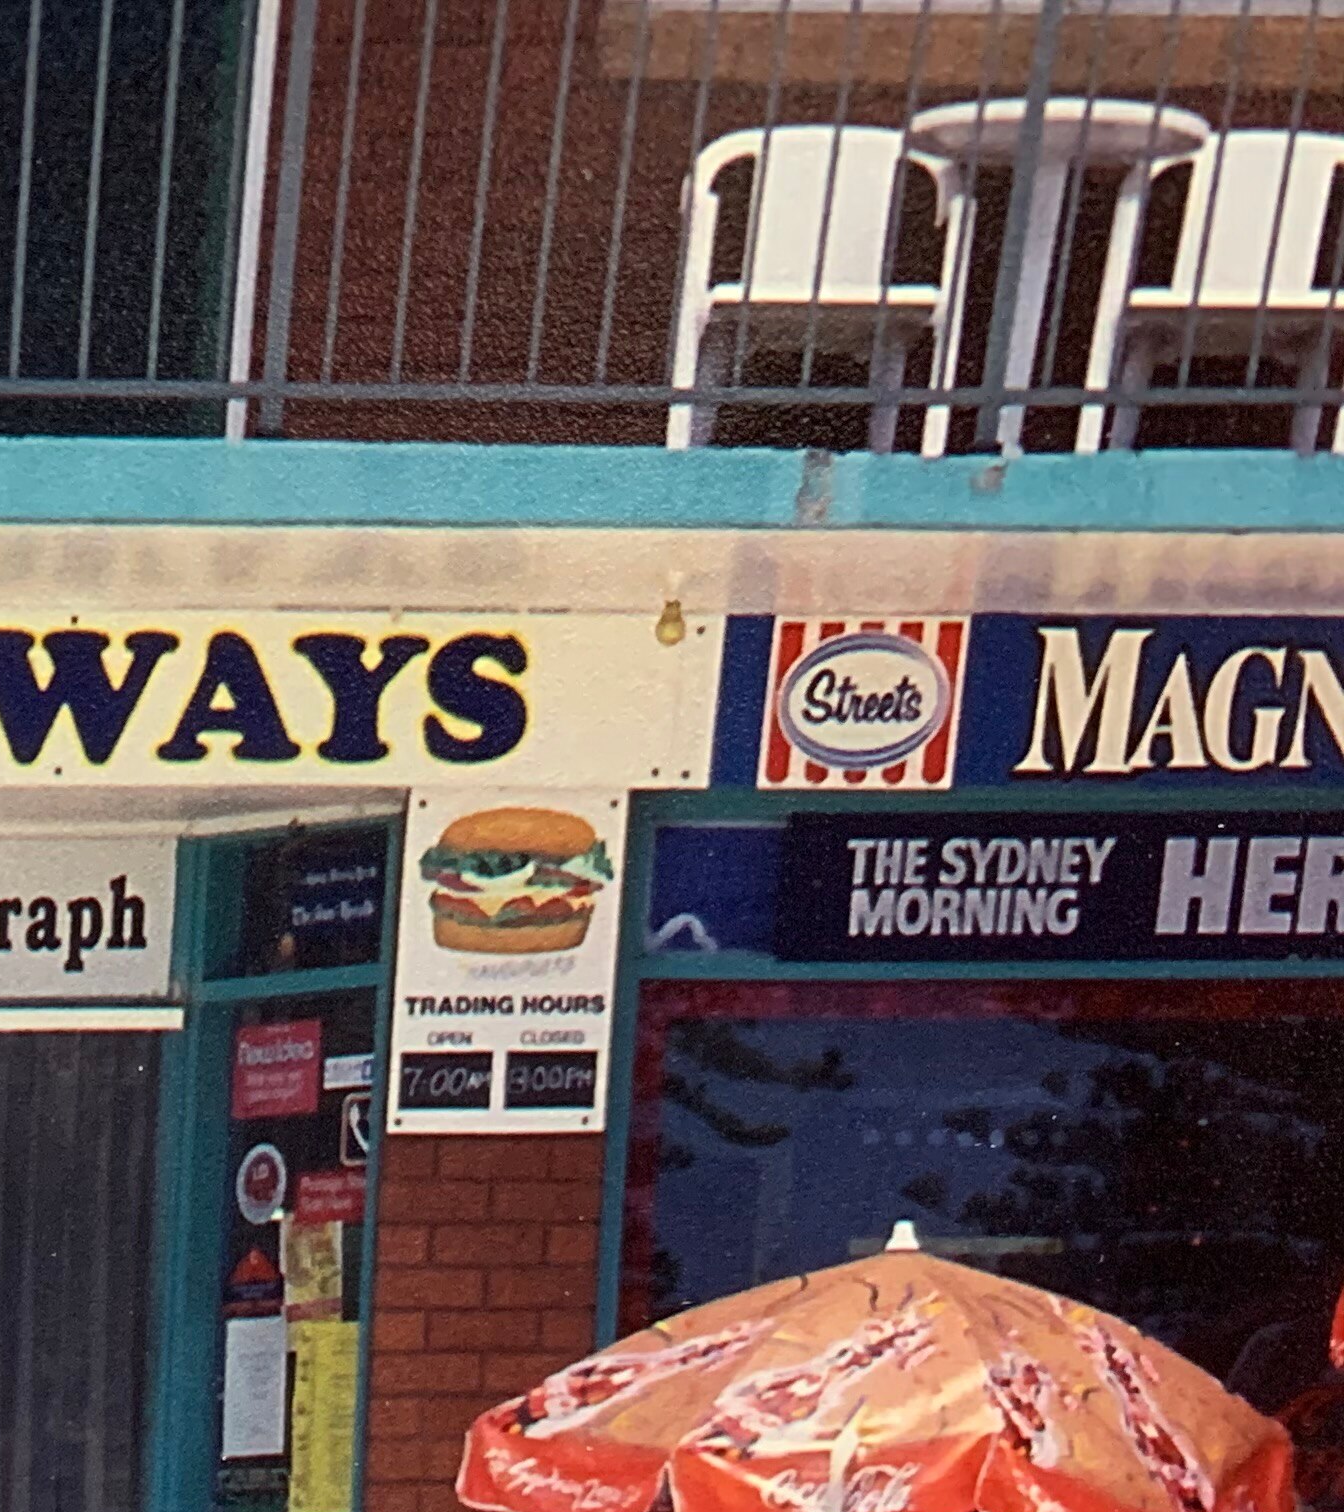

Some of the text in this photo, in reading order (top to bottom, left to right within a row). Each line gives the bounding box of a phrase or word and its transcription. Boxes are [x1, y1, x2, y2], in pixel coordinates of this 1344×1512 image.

[802, 668, 923, 726] Streets
[1013, 627, 1344, 774] MAGN
[848, 838, 1116, 887] THE SYDNEY
[848, 889, 1080, 938] MORNING
[405, 994, 605, 1016] TRADING HOURS
[427, 1031, 473, 1045] OPEN
[520, 1030, 585, 1045] CLOSED
